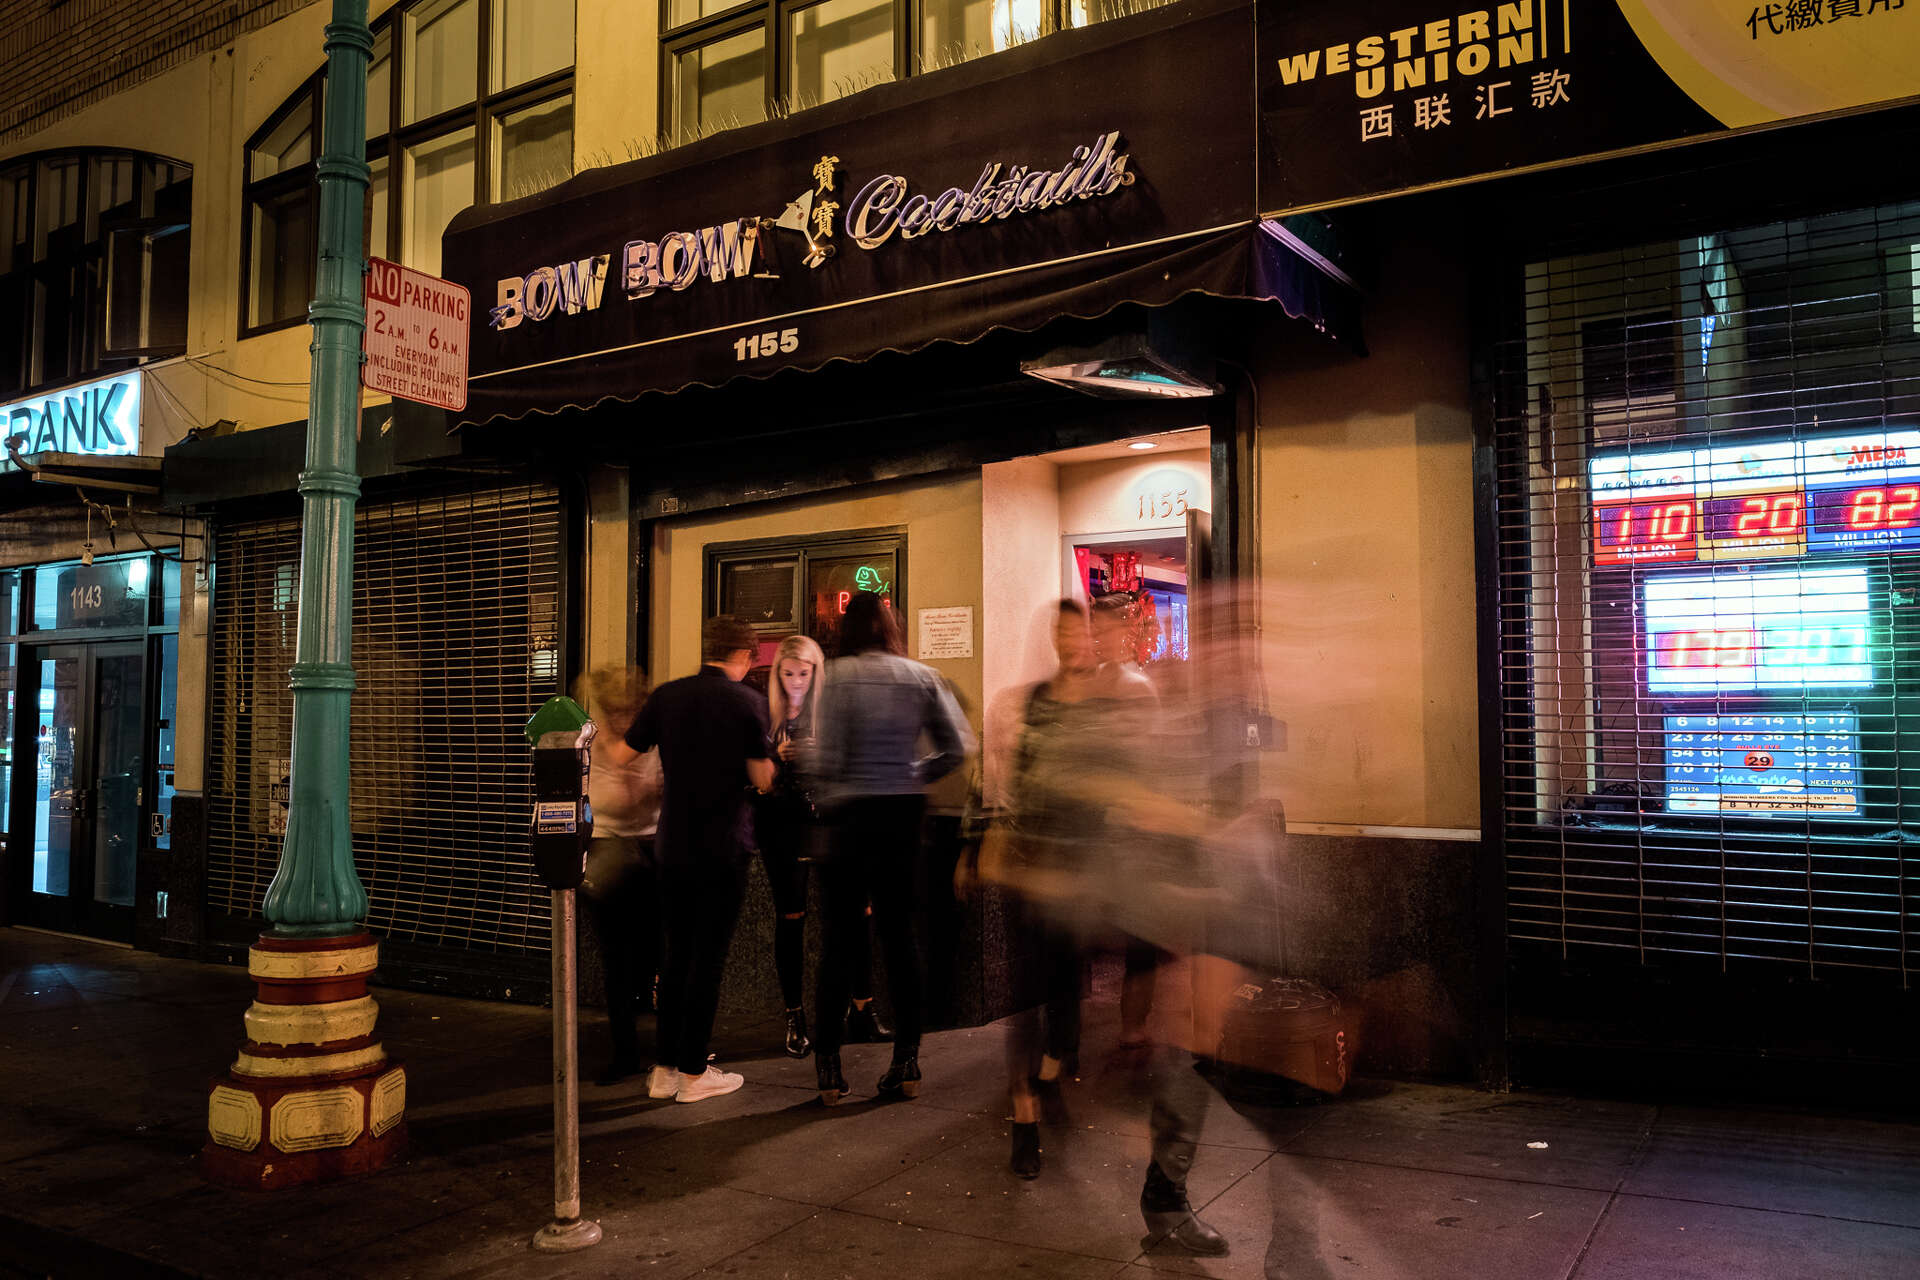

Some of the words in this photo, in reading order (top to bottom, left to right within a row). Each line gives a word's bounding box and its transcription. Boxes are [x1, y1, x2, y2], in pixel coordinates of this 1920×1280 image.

[1278, 0, 1534, 86] WESTERN
[1355, 32, 1534, 100] UNION
[1360, 69, 1572, 143] 西联汇款
[490, 254, 611, 331] BOW
[622, 216, 761, 301] BOW
[845, 131, 1135, 250] Cocktails
[370, 262, 399, 300] NO
[404, 281, 465, 322] PARKING
[374, 309, 386, 335] 2
[428, 327, 439, 350] 6
[733, 327, 799, 361] 1155
[370, 353, 417, 377] INCLUDING
[420, 368, 461, 388] HOLIDAYS
[395, 345, 439, 367] EVERYDAY
[376, 373, 408, 391] STREET
[410, 381, 453, 403] CLEANING
[8, 382, 129, 457] BANK
[1847, 444, 1907, 466] MEGA
[1136, 488, 1189, 521] 1155
[1738, 497, 1800, 535] 20
[1851, 488, 1918, 528] 82
[1617, 544, 1677, 559] MILLION
[1834, 530, 1903, 547] MILLION
[70, 584, 102, 609] 1143
[1748, 756, 1771, 767] 29
